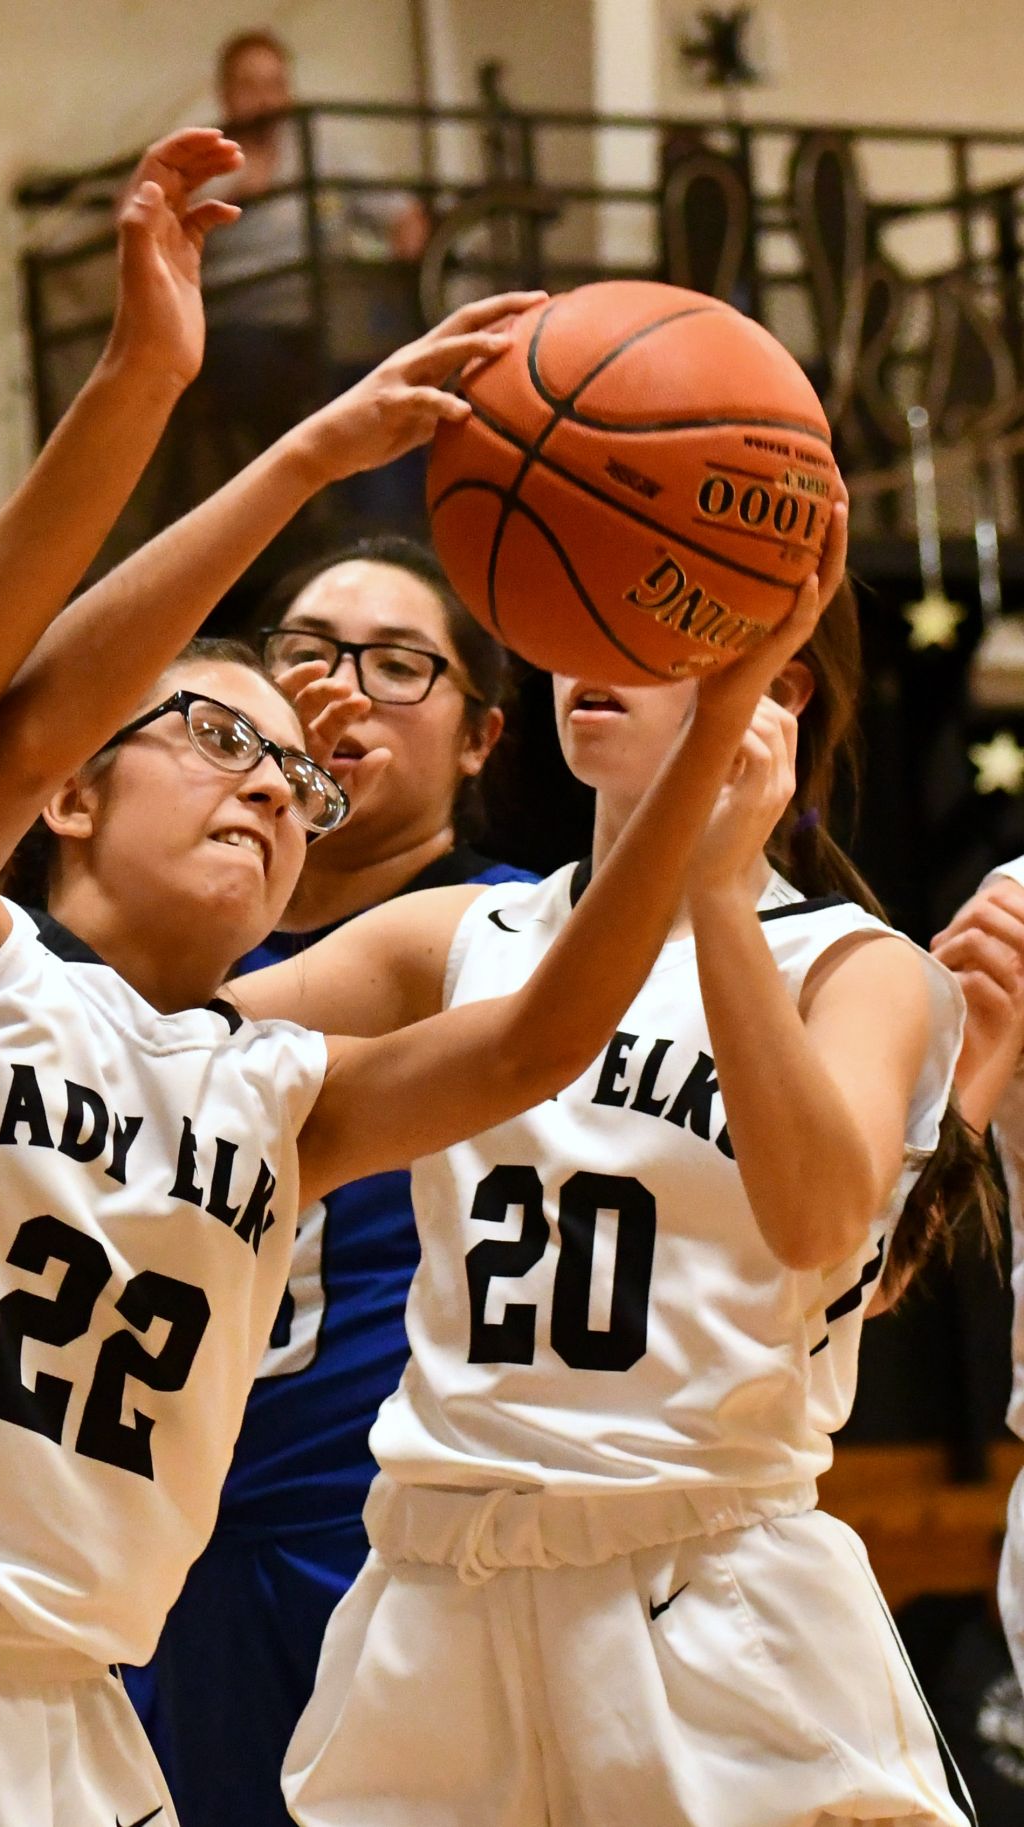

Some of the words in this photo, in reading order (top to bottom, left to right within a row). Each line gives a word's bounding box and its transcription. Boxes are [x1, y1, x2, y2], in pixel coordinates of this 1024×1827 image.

[698, 473, 817, 543] 1000
[625, 554, 761, 650] DING
[590, 1030, 736, 1161] ELK
[464, 1164, 657, 1372] 20
